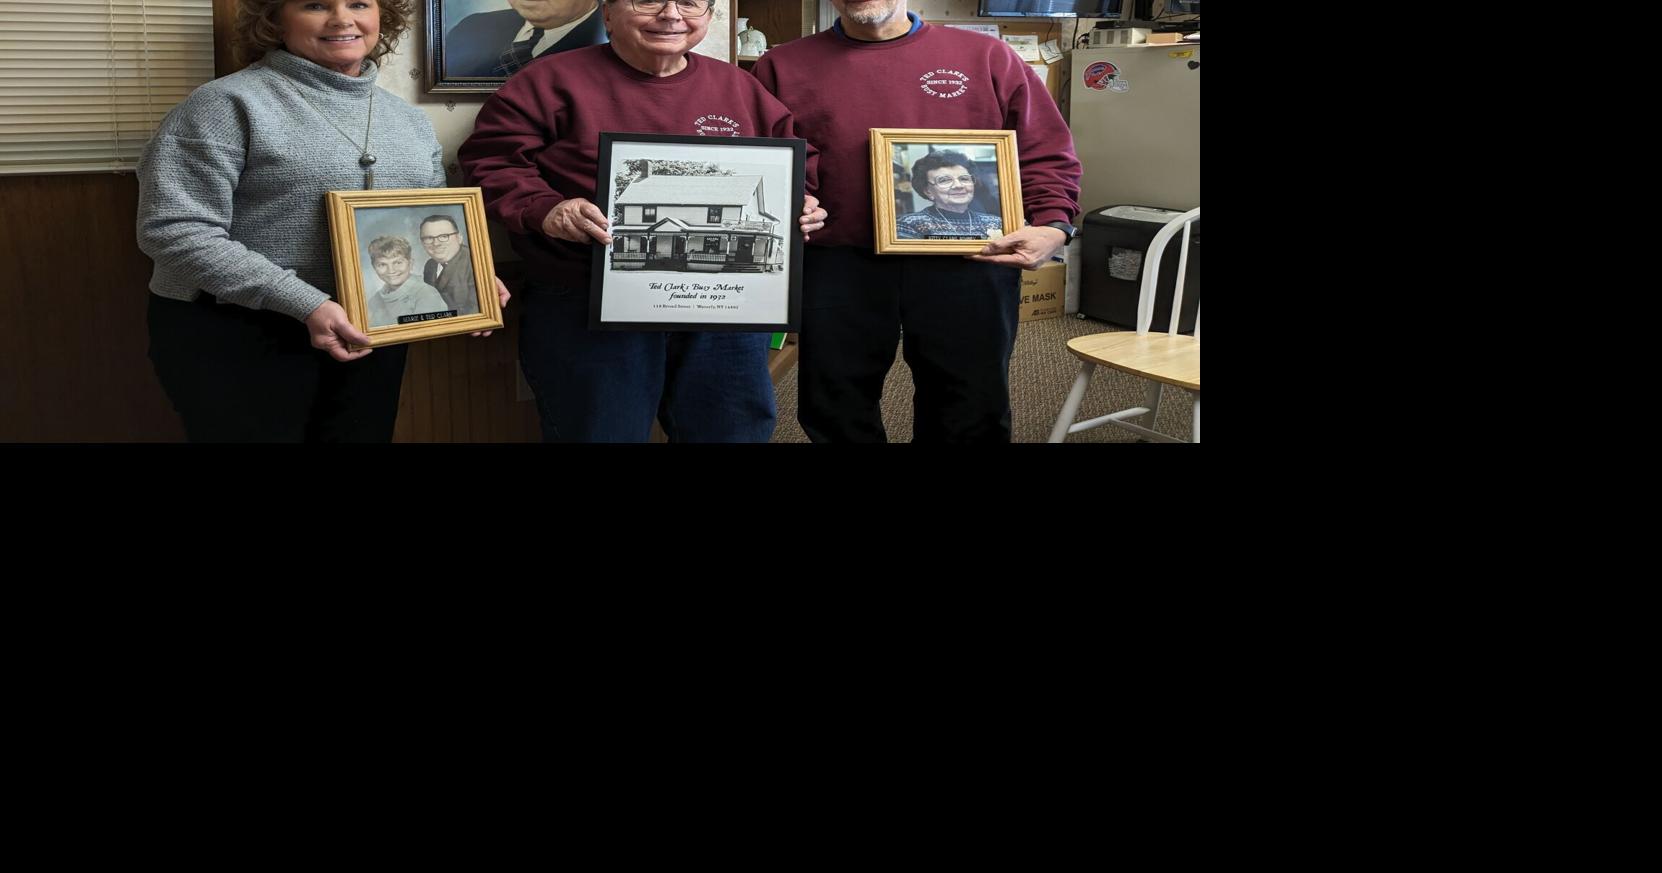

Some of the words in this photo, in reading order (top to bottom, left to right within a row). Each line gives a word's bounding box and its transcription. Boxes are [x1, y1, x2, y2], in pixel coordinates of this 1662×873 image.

[920, 71, 935, 81] TED
[936, 70, 969, 81] CLARK'S
[921, 85, 937, 96] BUSY
[939, 85, 967, 98] MARKET
[694, 116, 706, 125] TED
[707, 115, 739, 127] CLARK'S
[664, 283, 689, 292] Clark's
[713, 284, 744, 293] Market
[669, 292, 697, 300] founded
[1032, 292, 1056, 302] MASK
